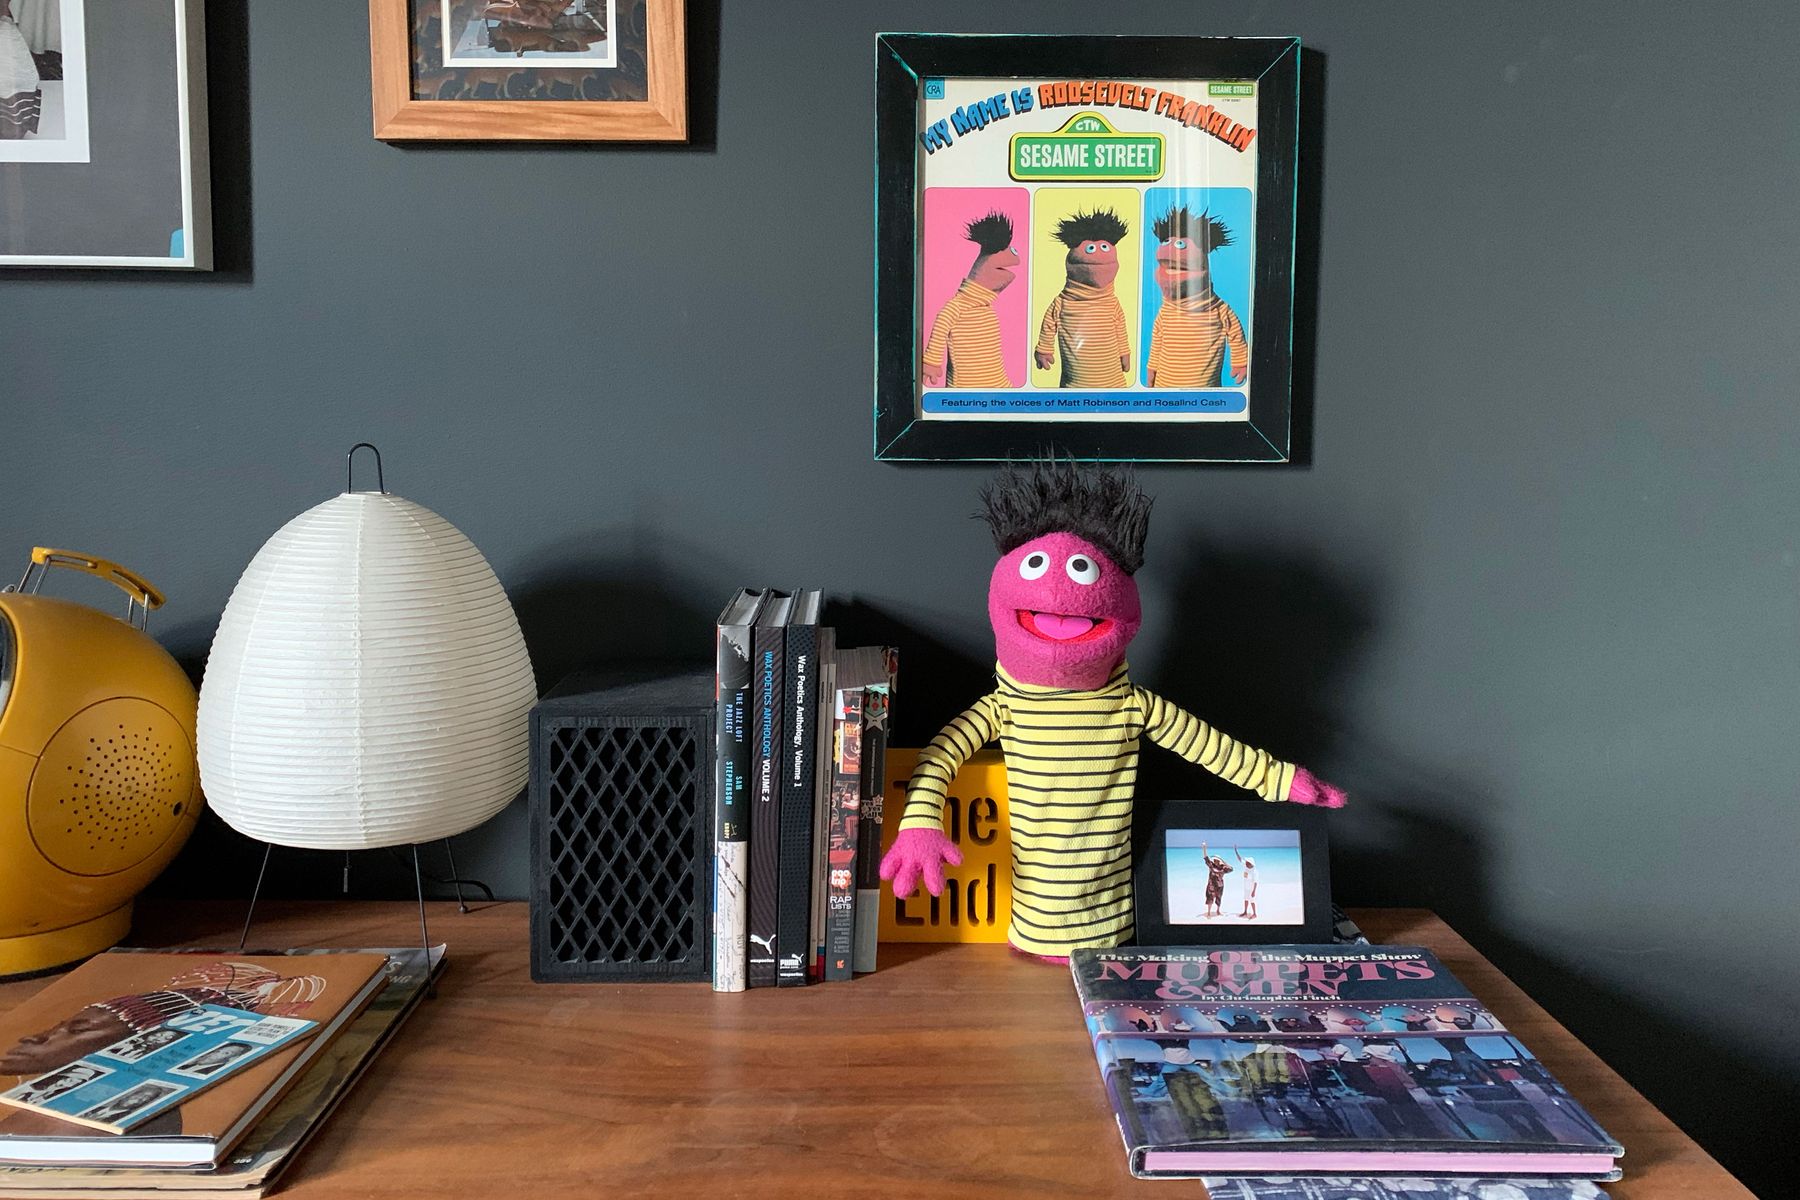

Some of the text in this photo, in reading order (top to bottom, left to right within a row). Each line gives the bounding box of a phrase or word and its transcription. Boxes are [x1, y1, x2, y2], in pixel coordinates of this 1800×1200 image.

[920, 81, 1257, 155] MY NAME IS ROOSEVELT FRANKLIN
[1076, 121, 1100, 132] CTW
[1020, 144, 1156, 169] SESAME STREET
[941, 398, 1226, 408] Featuring the voices of Matt Robinson and Rosalind Cash
[764, 651, 773, 668] WAX
[797, 655, 806, 673] Wax
[763, 669, 773, 706] POETICS
[796, 675, 806, 708] Poetics
[725, 704, 733, 734] PROJECT
[736, 707, 744, 724] JAZZ
[793, 708, 805, 748] Anthology,
[735, 725, 743, 743] LOFT
[762, 707, 772, 758] ANTHOLOGY
[761, 758, 770, 794] VOLUME
[794, 750, 804, 780] Volume
[725, 761, 733, 805] STEPHENSON
[1096, 954, 1134, 962] The
[1137, 954, 1211, 963] Making
[1209, 951, 1263, 963] OF
[1294, 954, 1368, 963] Muppet
[1095, 960, 1436, 983] MUPPETS
[1217, 980, 1342, 995] MEN
